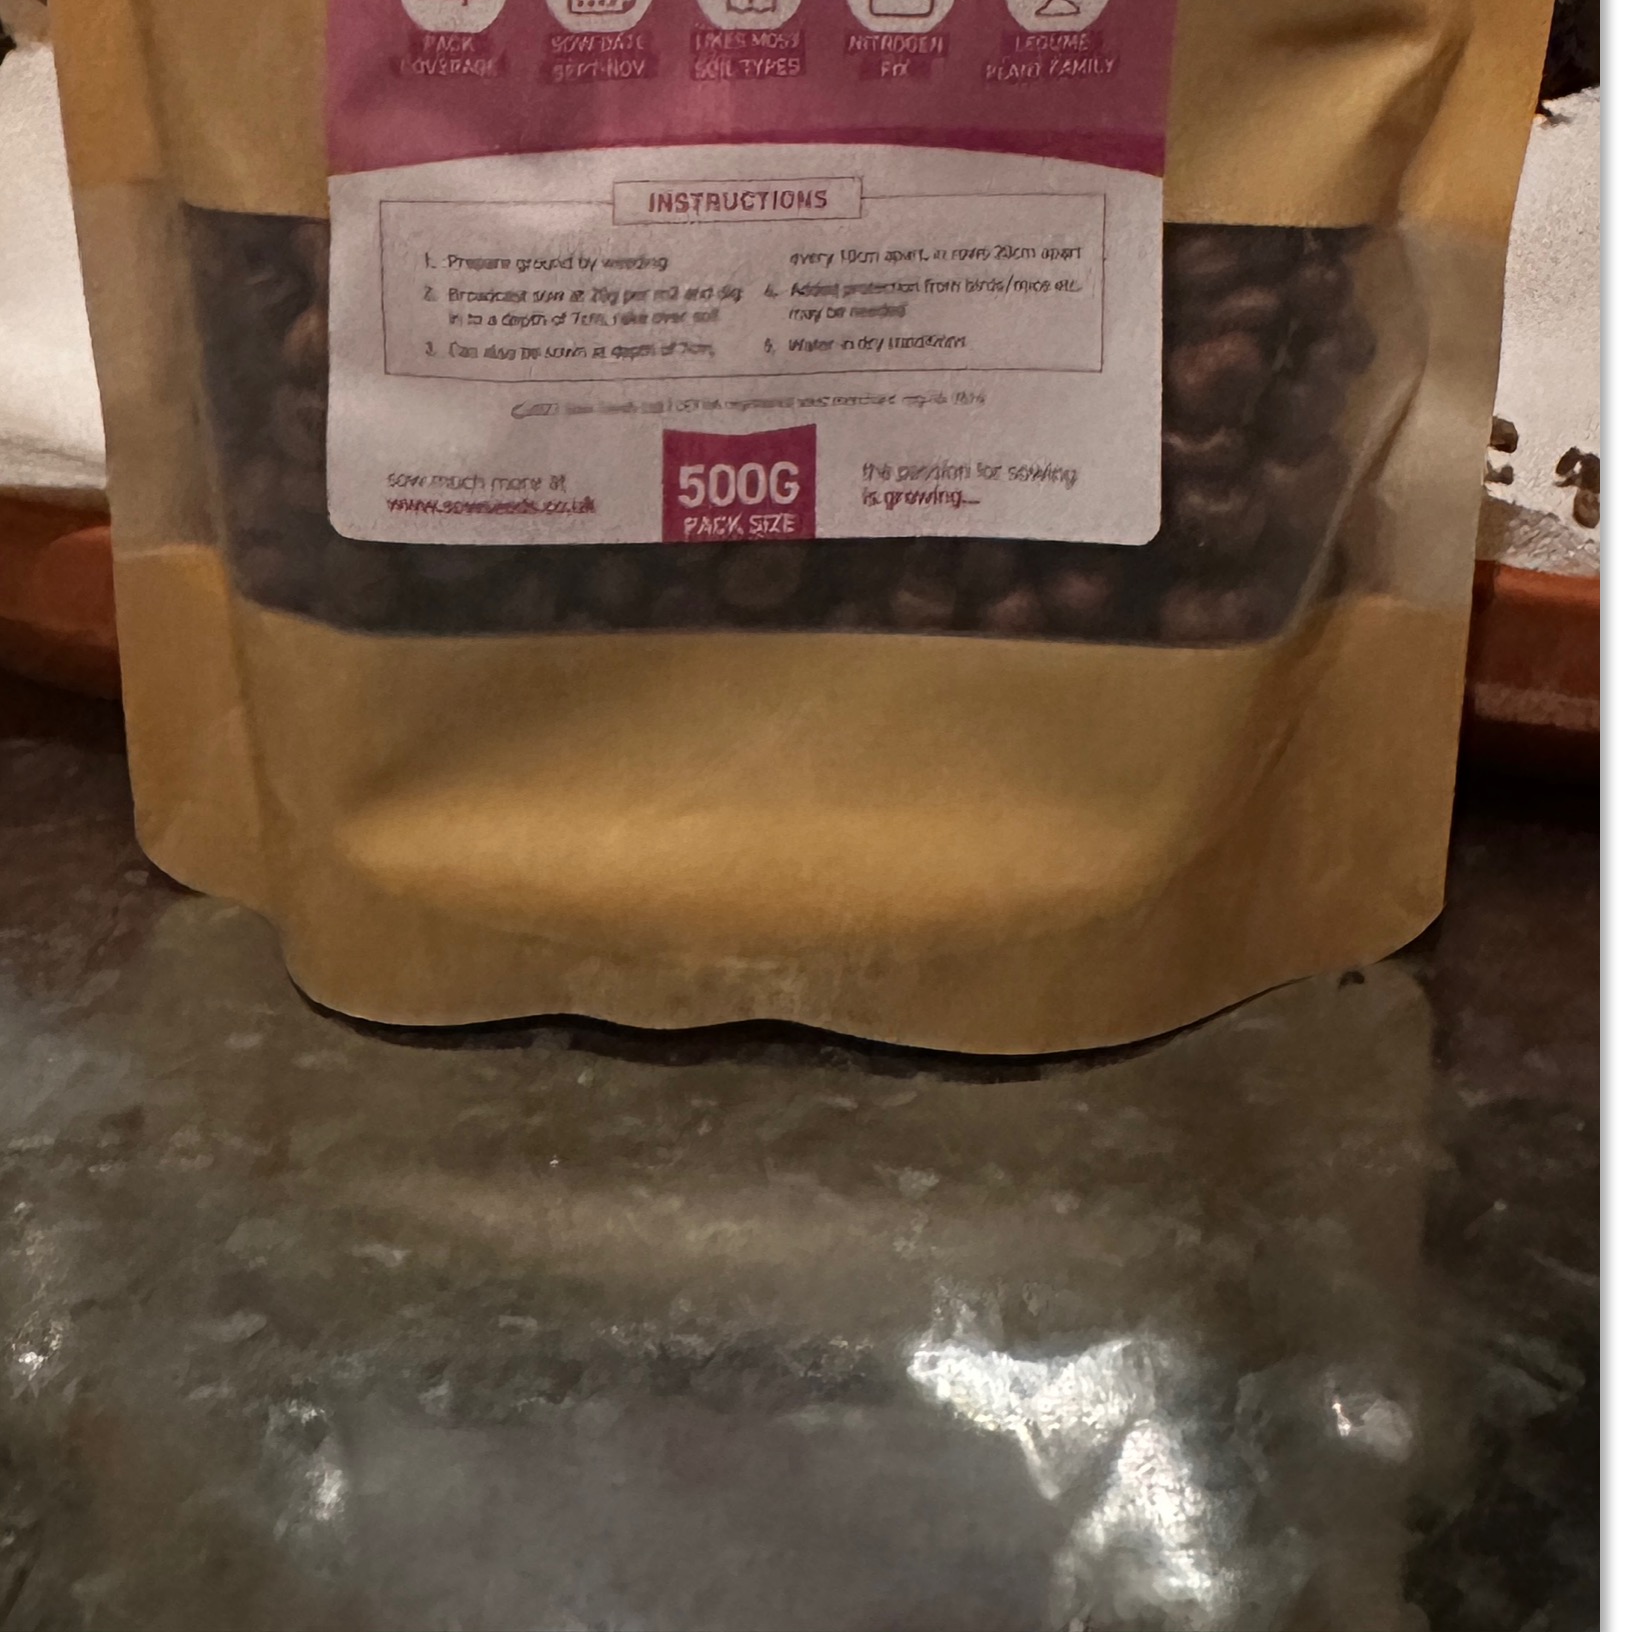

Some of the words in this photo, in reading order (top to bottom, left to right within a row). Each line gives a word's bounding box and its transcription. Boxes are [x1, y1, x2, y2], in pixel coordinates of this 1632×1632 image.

[647, 189, 828, 213] INSTRUCTIONS
[677, 461, 801, 508] 500G
[748, 512, 797, 538] SIZE
